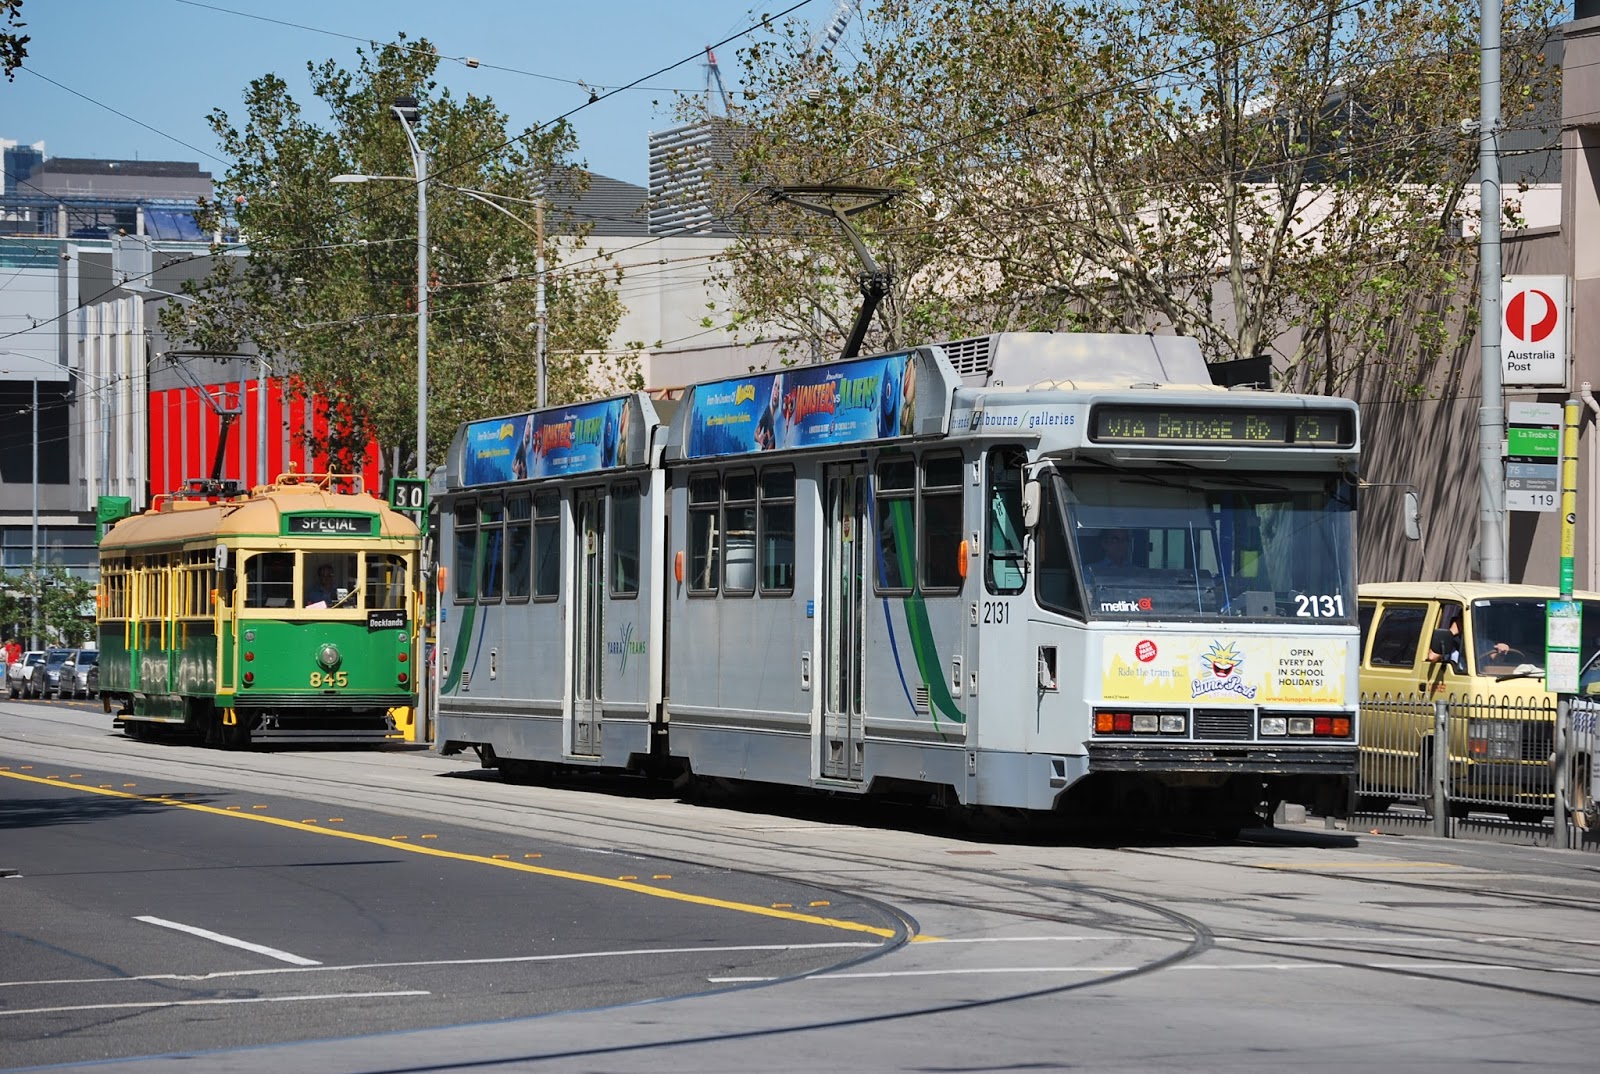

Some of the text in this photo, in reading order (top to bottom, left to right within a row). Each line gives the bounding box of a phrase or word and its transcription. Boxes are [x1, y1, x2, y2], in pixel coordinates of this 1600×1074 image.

[1507, 350, 1555, 360] Australia
[1507, 362, 1531, 371] Post
[794, 381, 836, 425] MONSTERS
[837, 375, 879, 416] ALIENS
[1029, 412, 1075, 428] galleries
[1108, 418, 1145, 437] VIA
[1158, 413, 1233, 439] BRIDGE
[1528, 431, 1548, 439] Trobe
[1509, 465, 1520, 474] 75
[1509, 480, 1520, 488] 86
[395, 486, 423, 507] 30
[1531, 494, 1554, 506] 119
[302, 517, 357, 531] SPECIAL
[1101, 600, 1140, 613] metlink
[1294, 594, 1345, 618] 2131
[983, 601, 1009, 625] 2131
[369, 618, 404, 627] Docklands
[607, 641, 646, 654] YARRA TRAMS
[1118, 666, 1134, 677] Ride
[1136, 668, 1149, 677] the
[1151, 668, 1169, 677] tram
[309, 671, 348, 688] 845
[1278, 678, 1323, 686] HOLIDAYS!
[1191, 675, 1257, 699] Luna Park
